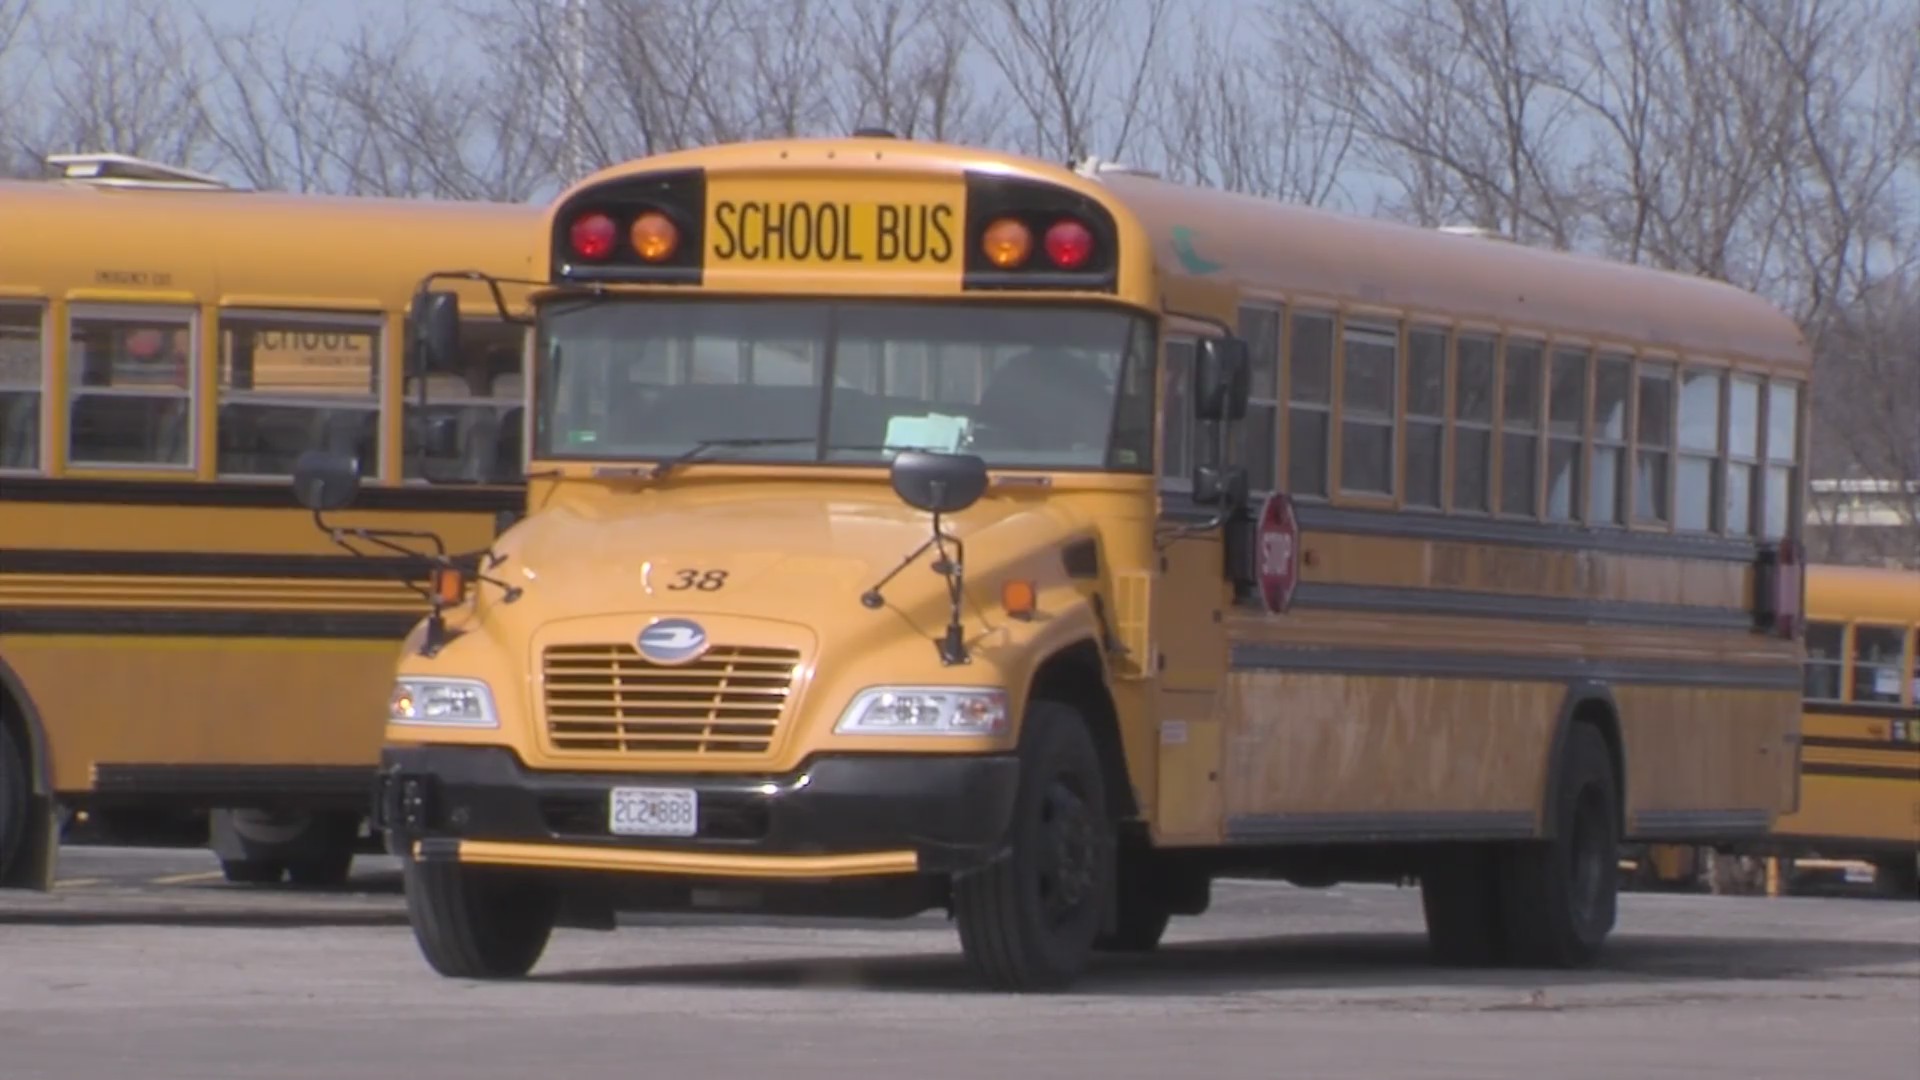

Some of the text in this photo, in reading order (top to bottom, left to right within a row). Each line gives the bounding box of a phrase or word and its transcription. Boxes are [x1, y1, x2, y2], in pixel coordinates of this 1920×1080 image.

[714, 202, 953, 263] SCHOOL BUS
[1261, 532, 1291, 575] STOP
[666, 569, 730, 592] 38
